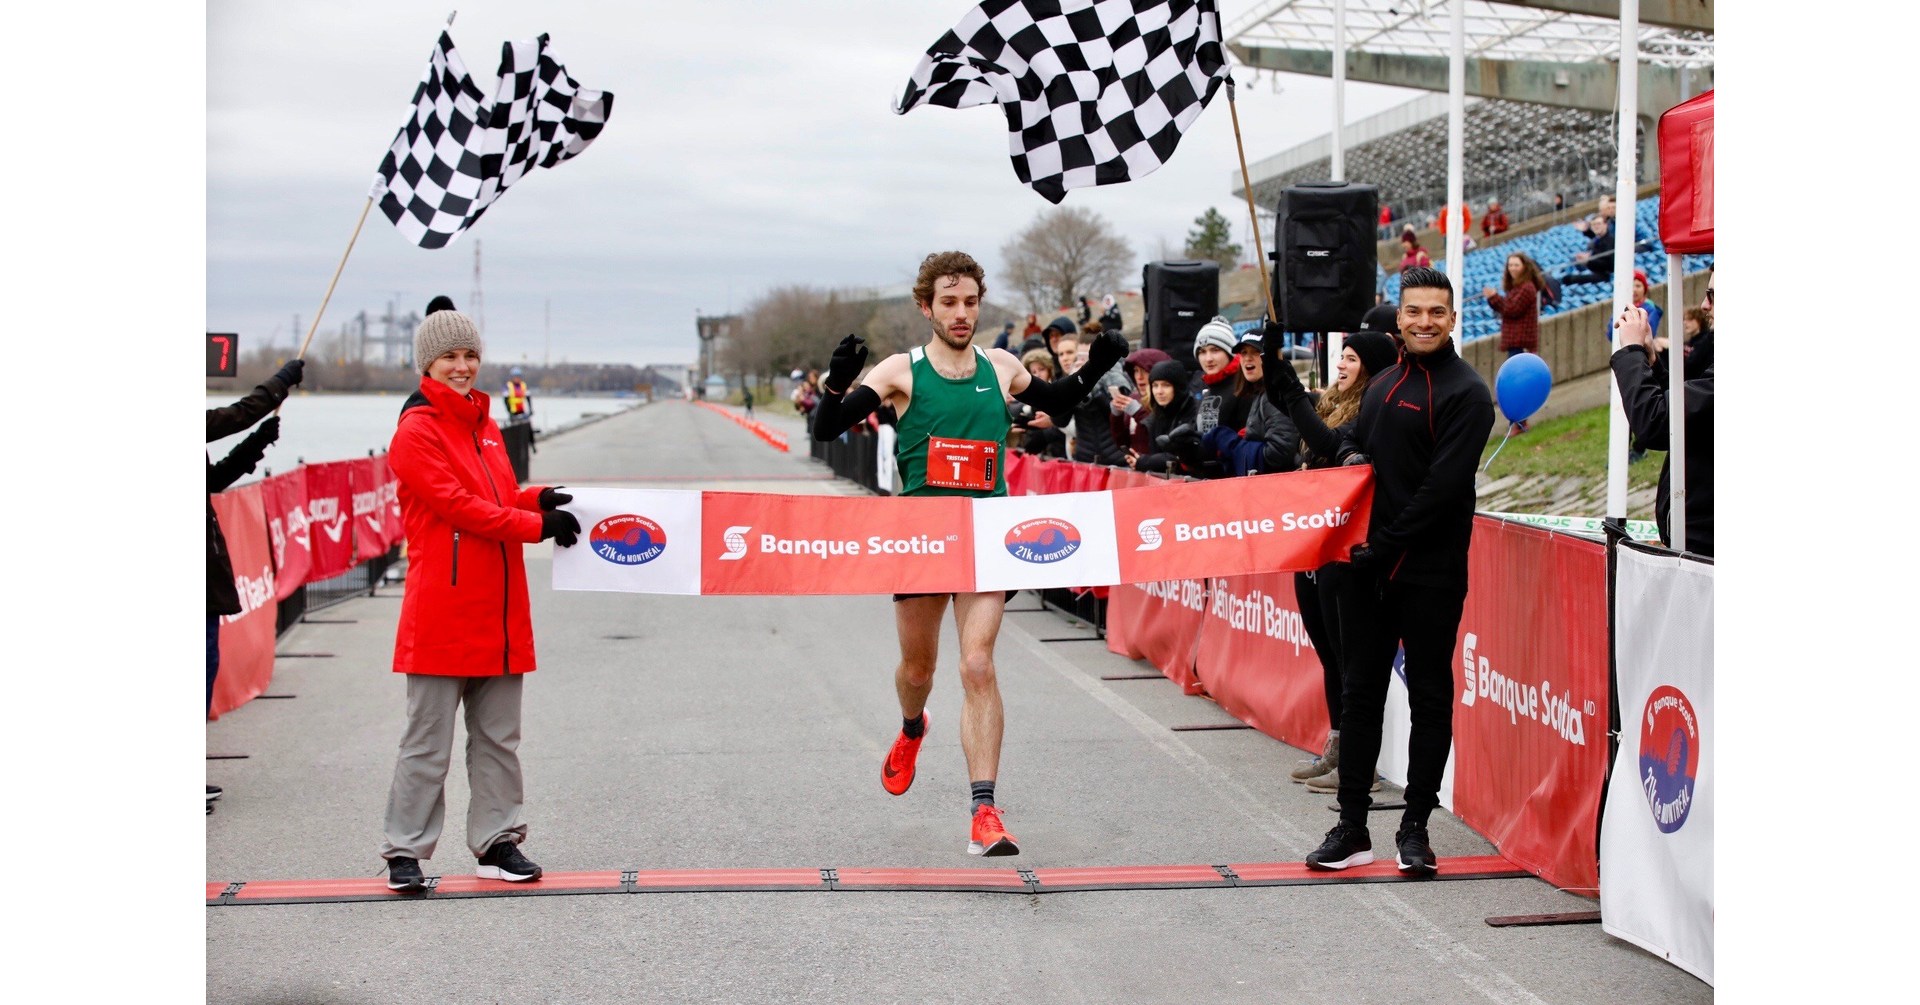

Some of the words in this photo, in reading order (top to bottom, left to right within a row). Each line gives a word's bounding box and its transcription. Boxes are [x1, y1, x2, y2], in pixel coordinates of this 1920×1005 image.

[212, 336, 229, 370] 7
[952, 462, 960, 480] 1
[608, 517, 634, 527] Banque
[636, 517, 656, 531] Scotia
[1175, 518, 1274, 542] Banque
[617, 553, 626, 562] de
[627, 546, 661, 563] MONTRÉAL
[760, 534, 860, 559] Banque
[867, 535, 945, 555] Scotia
[1043, 543, 1077, 561] MONTRÉAL
[1479, 656, 1537, 725] Banque
[1541, 680, 1585, 746] Scotia
[1584, 700, 1595, 716] MD
[1654, 695, 1678, 714] Banque
[1660, 784, 1690, 825] MONTRÉAL
